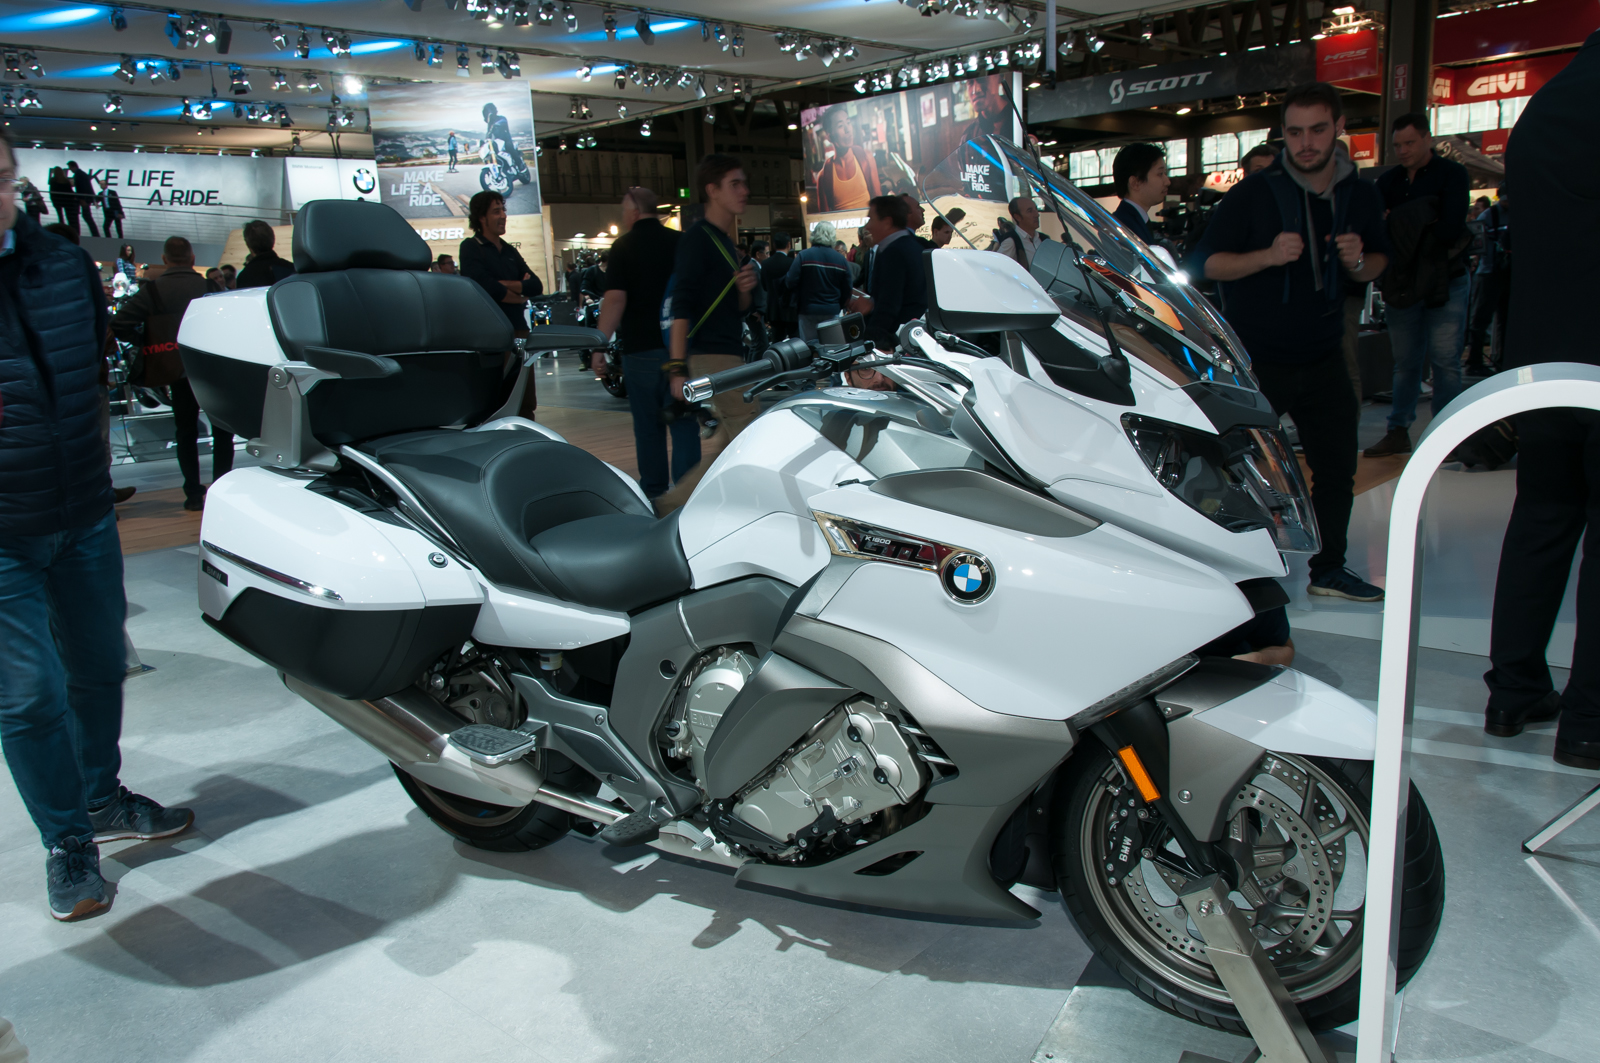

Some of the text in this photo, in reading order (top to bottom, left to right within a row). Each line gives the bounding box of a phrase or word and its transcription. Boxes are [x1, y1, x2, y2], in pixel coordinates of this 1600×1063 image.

[1126, 71, 1212, 96] SCOTT
[1467, 70, 1527, 96] GIVI
[403, 171, 444, 183] MAKE
[965, 164, 990, 176] MAKE
[127, 169, 175, 187] LIFE
[960, 171, 985, 184] LIFE A
[391, 182, 434, 196] LIFE A
[971, 182, 992, 193] RIDE.
[147, 189, 222, 206] A RIDE.
[409, 194, 445, 207] RIDE.
[415, 227, 465, 241] DSTER
[950, 555, 989, 574] BMW
[1118, 836, 1133, 863] BMW
